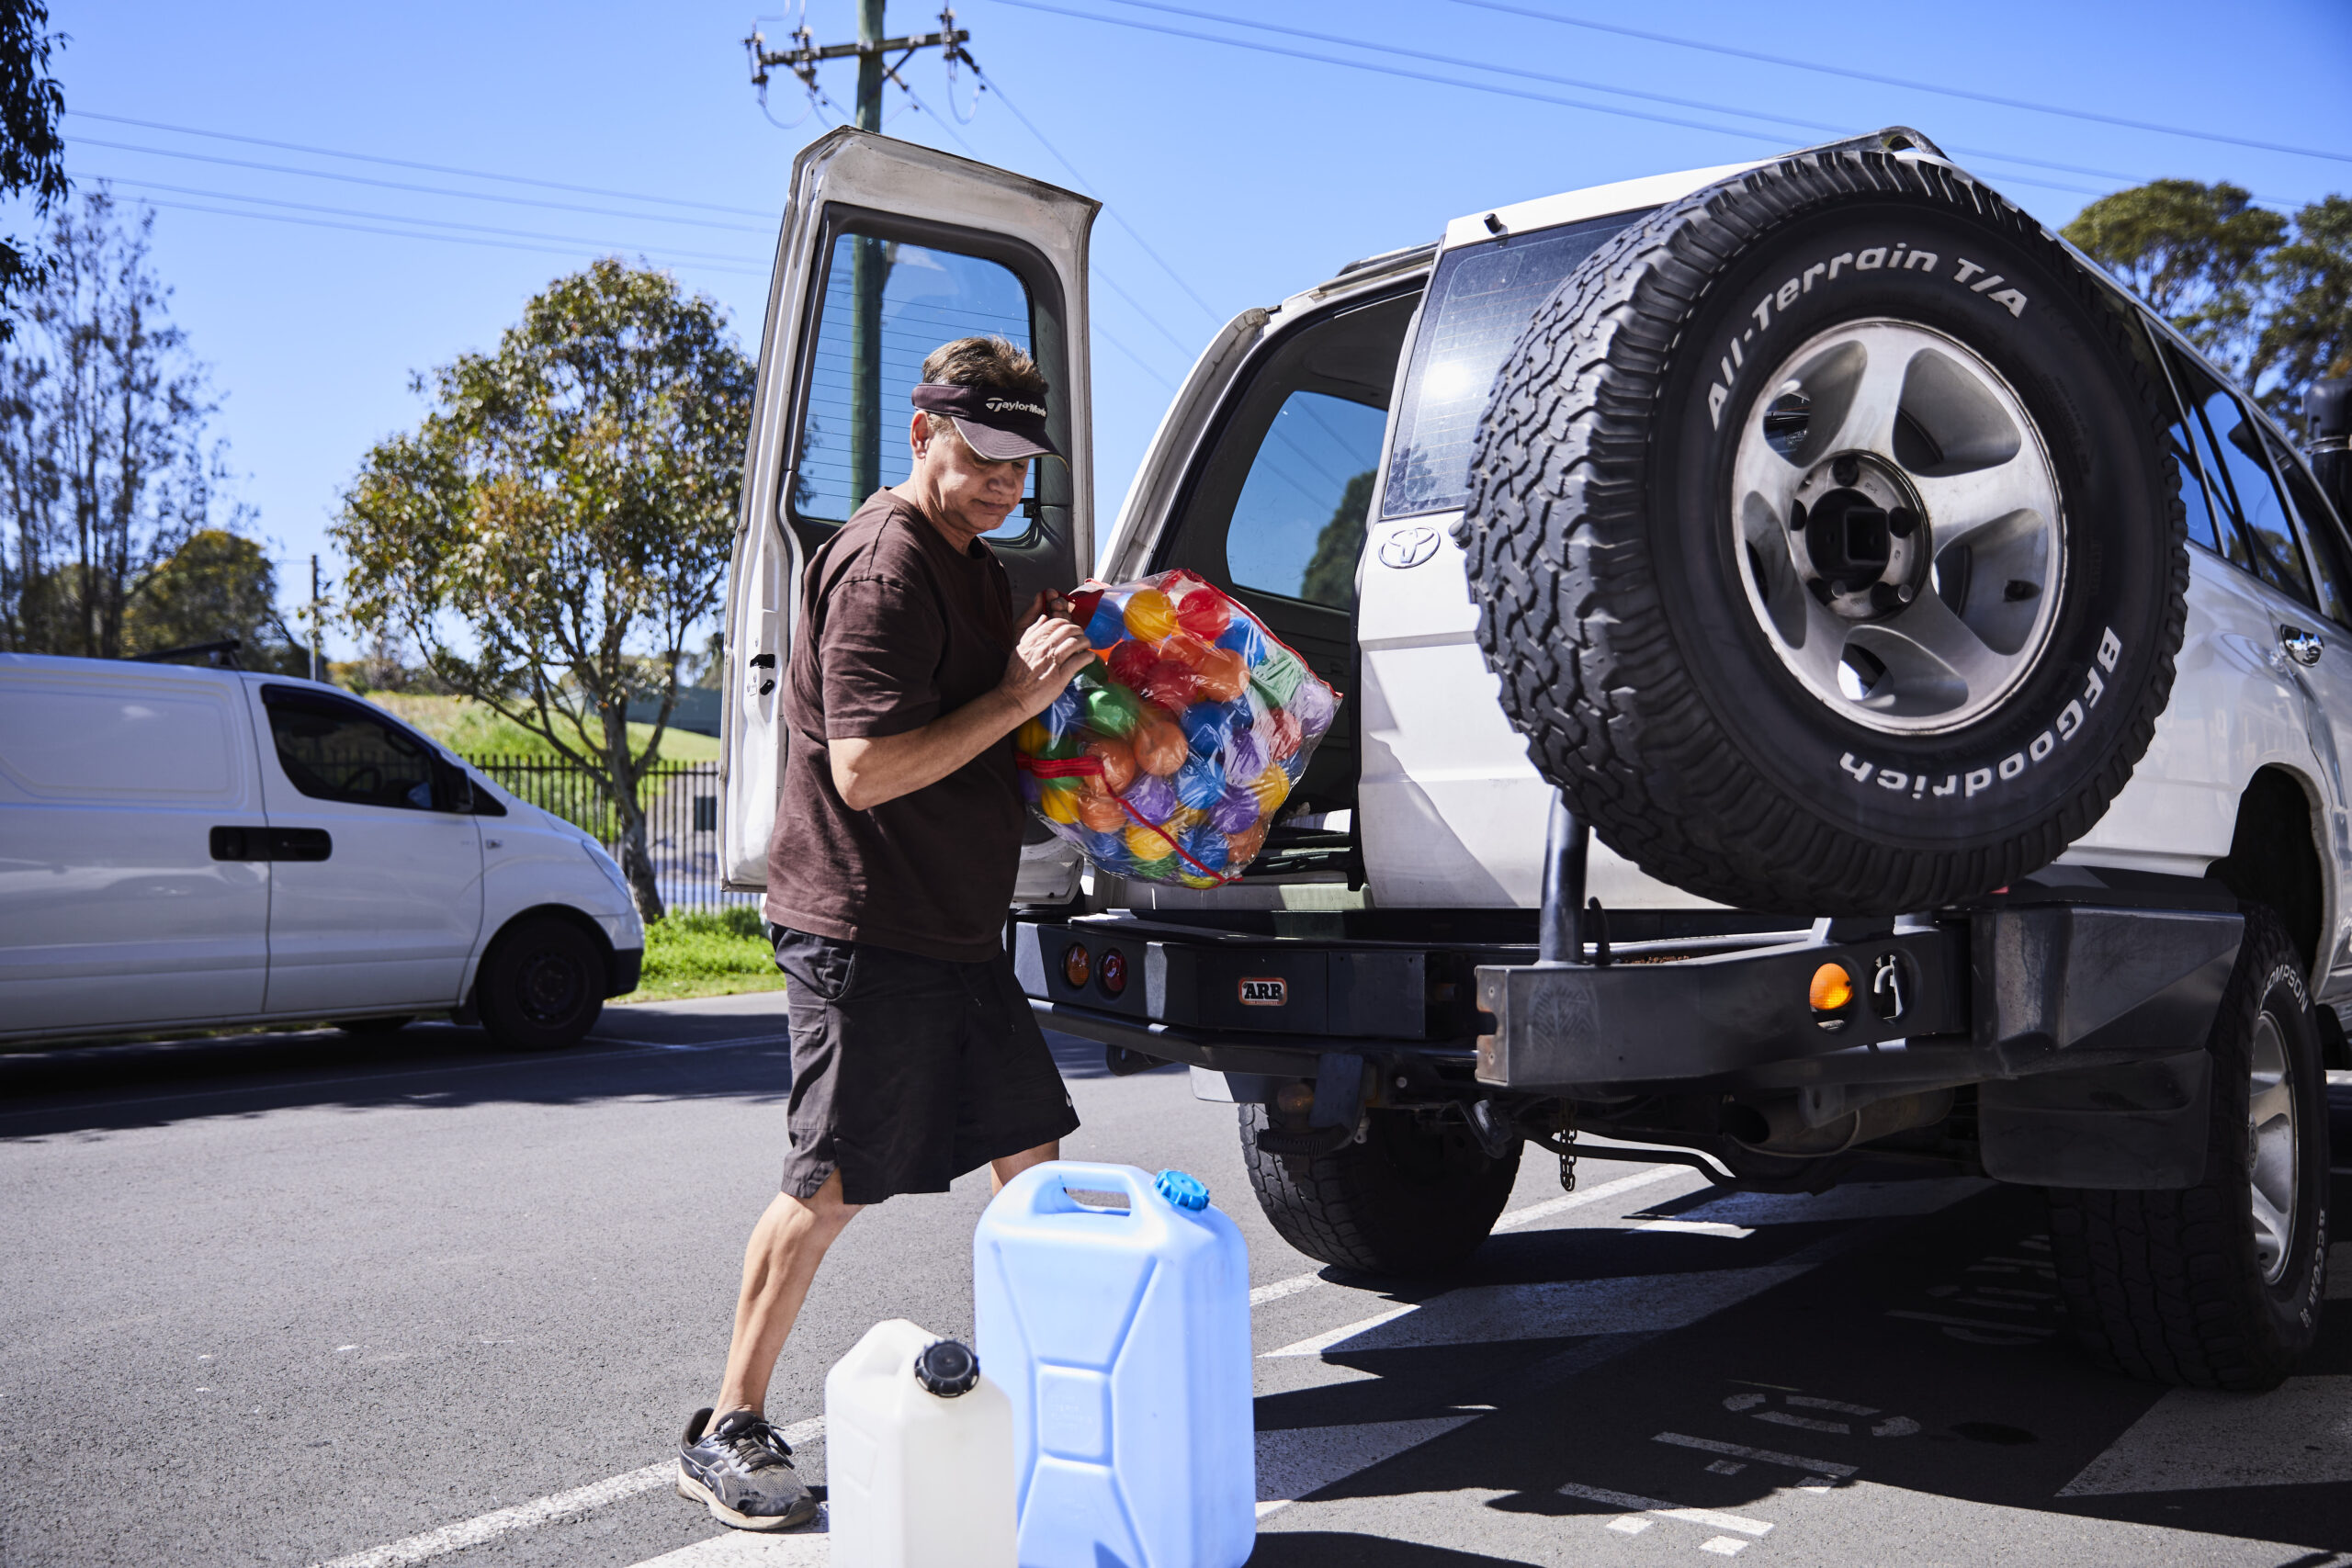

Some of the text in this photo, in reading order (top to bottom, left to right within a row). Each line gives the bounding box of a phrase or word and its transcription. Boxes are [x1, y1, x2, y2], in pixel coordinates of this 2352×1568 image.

[1707, 243, 1939, 431] All-Terrain
[1953, 256, 2030, 319] T/A
[1840, 626, 2122, 799] BFGoodrich
